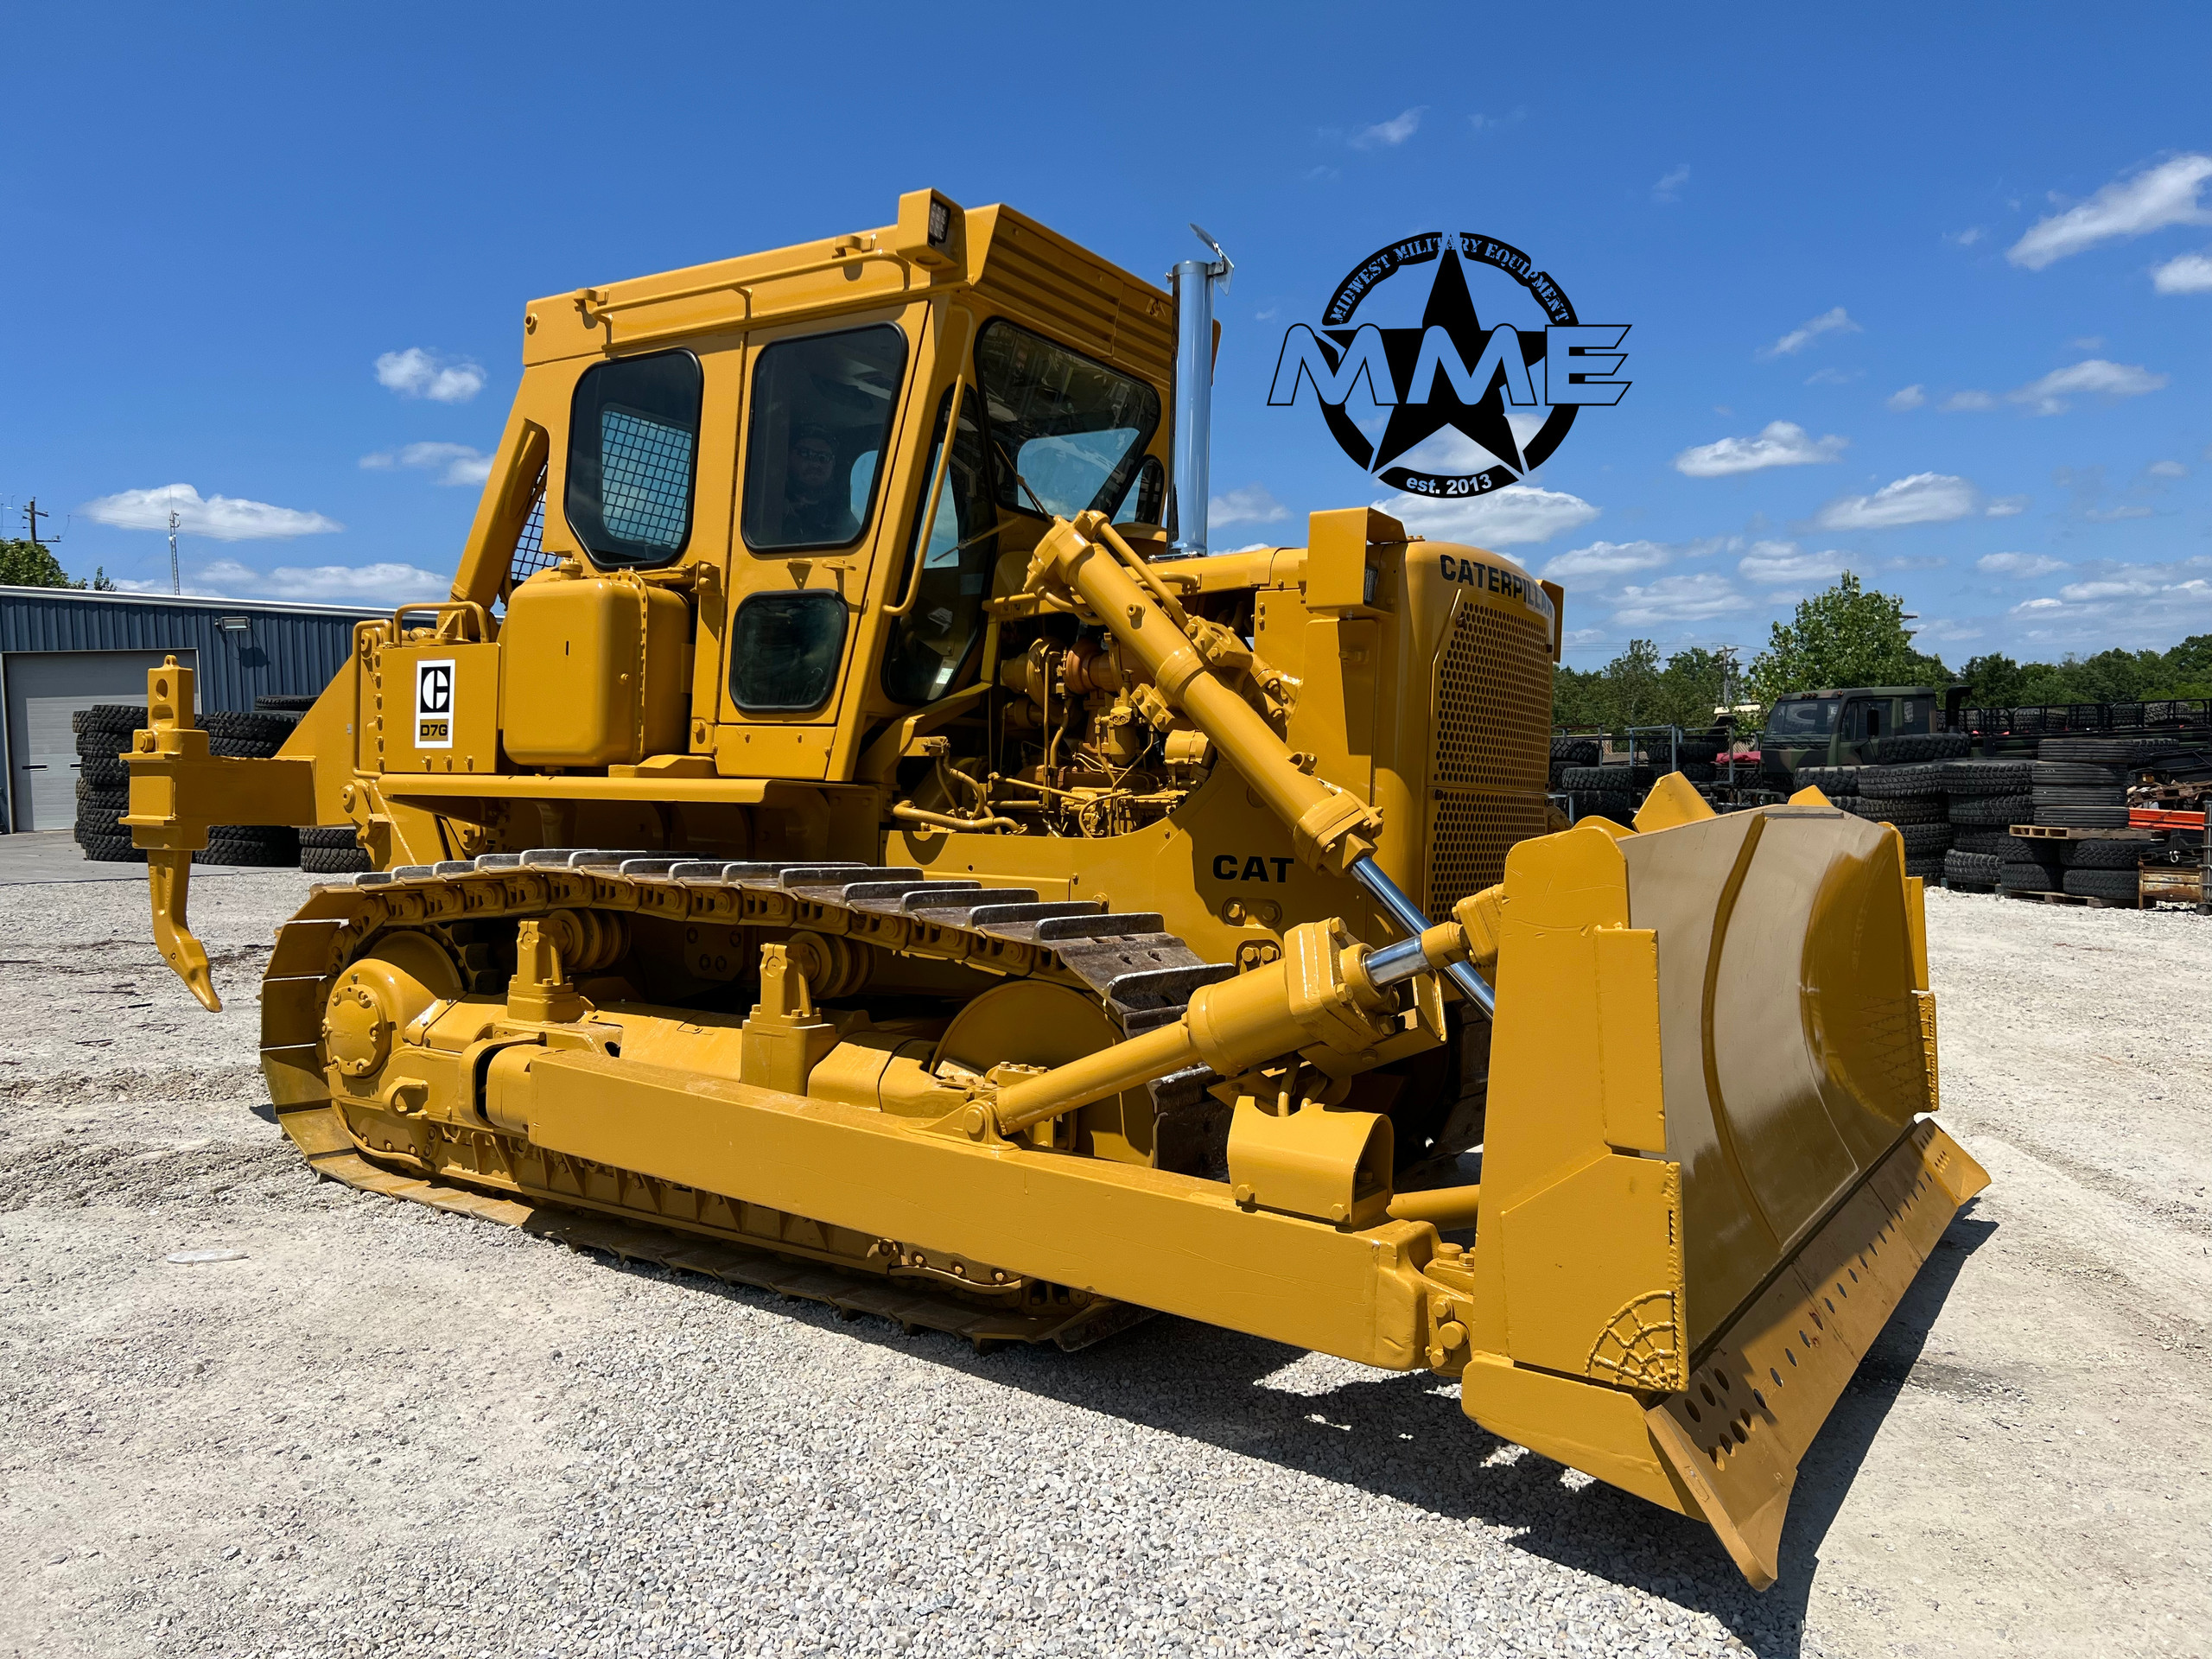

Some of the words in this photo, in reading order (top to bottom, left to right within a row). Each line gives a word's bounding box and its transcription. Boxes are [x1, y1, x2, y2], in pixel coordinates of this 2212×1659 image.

[1440, 554, 1554, 619] CATERPILLAR
[420, 724, 448, 736] D7G
[1212, 855, 1294, 883] CAT
